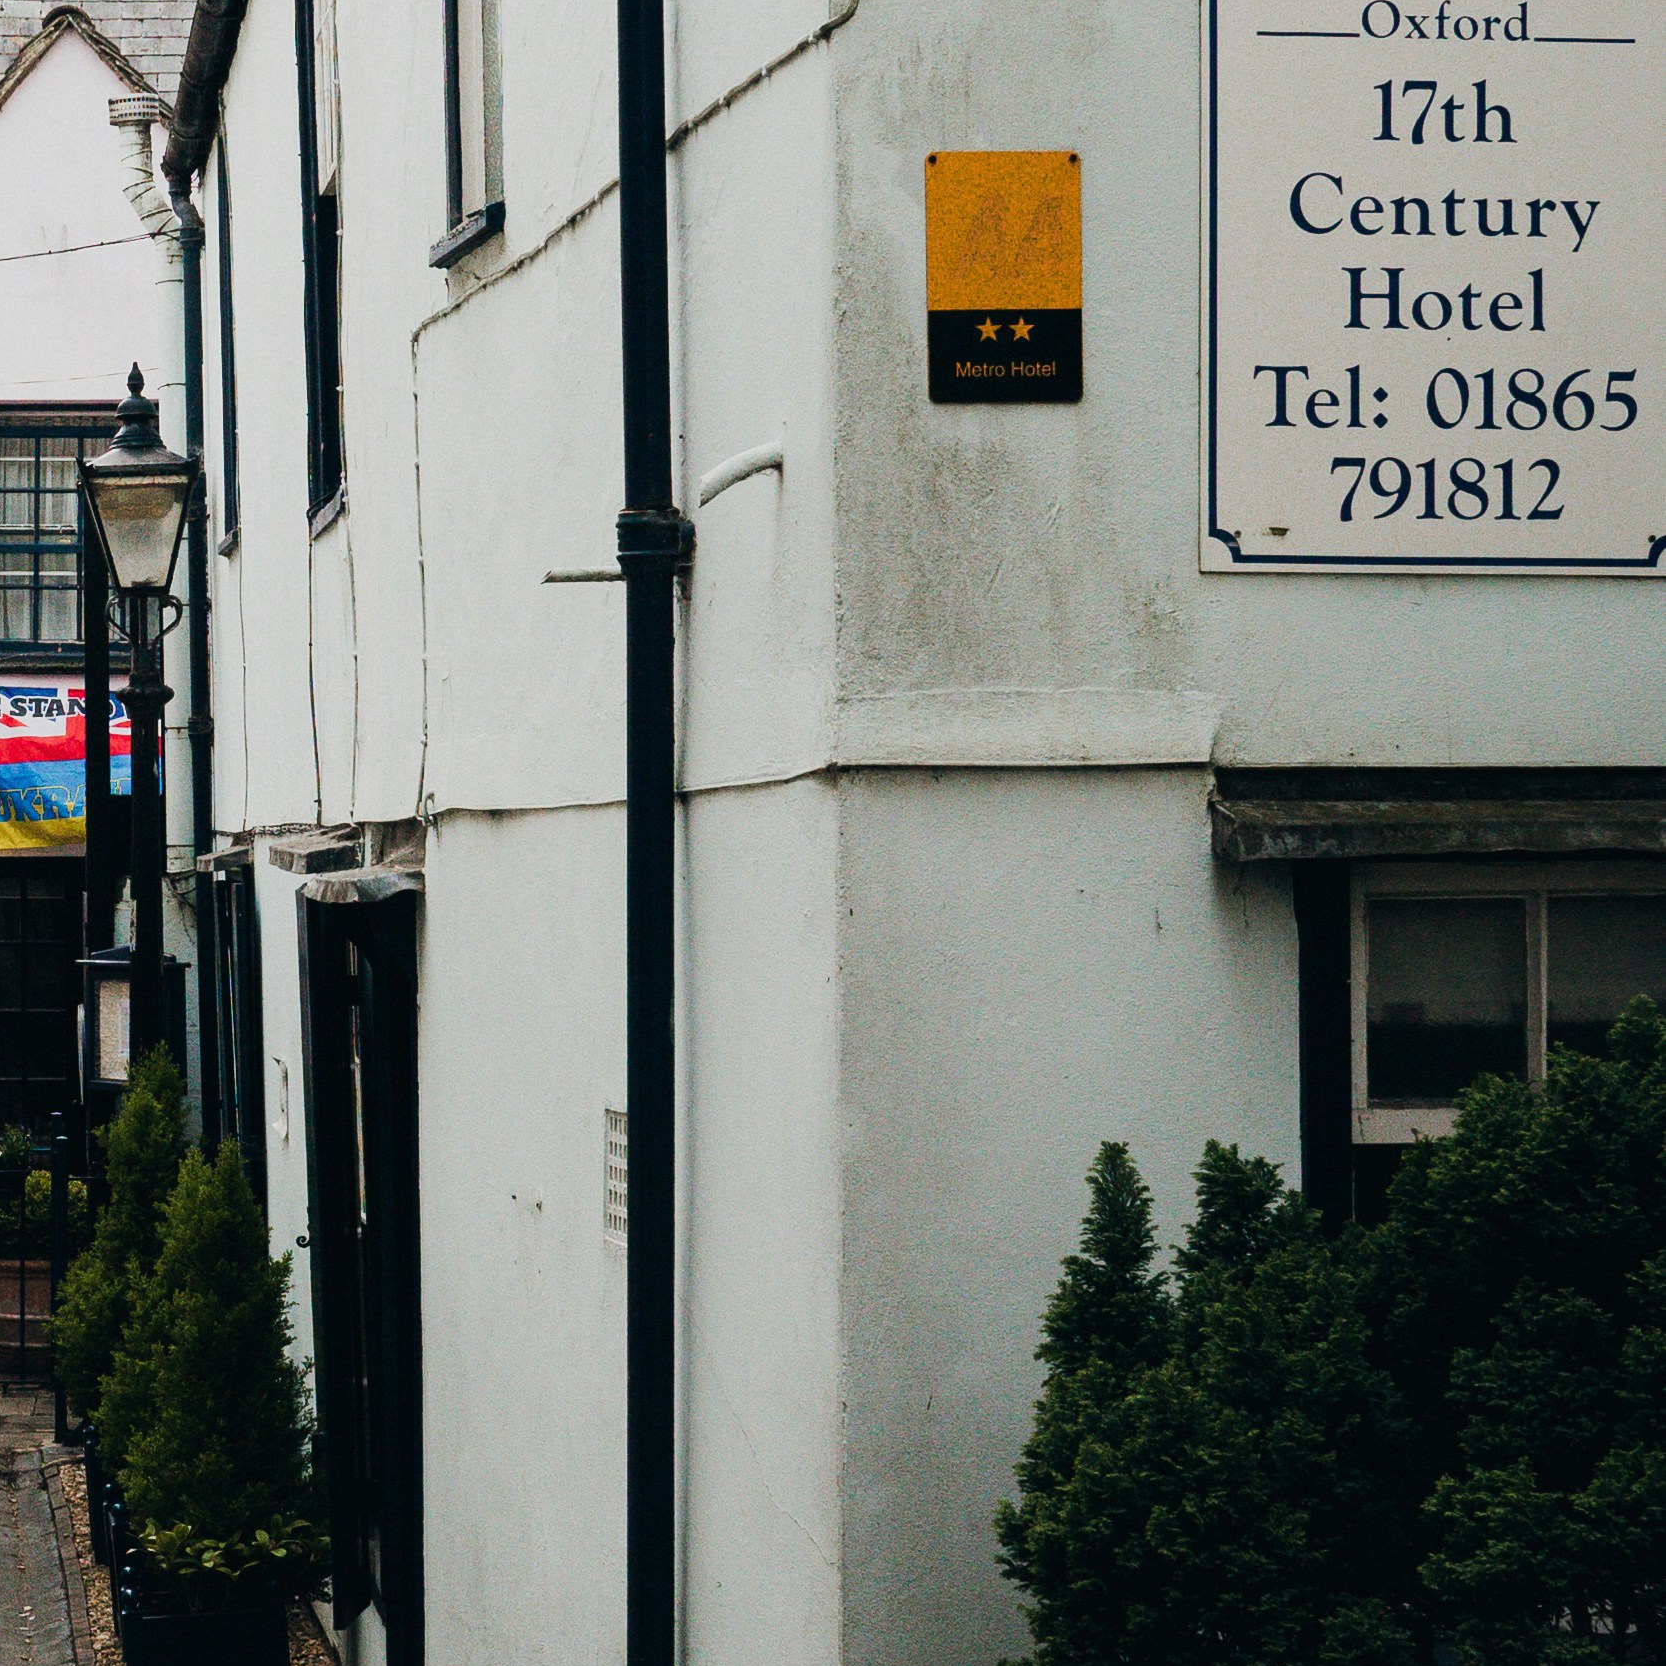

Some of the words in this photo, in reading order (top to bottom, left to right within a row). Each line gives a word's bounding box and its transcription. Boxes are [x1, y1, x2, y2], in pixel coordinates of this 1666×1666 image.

[1361, 0, 1530, 41] Oxford
[1372, 80, 1518, 144] 17th
[1289, 173, 1601, 252] Century
[1342, 267, 1547, 332] Hotel
[955, 361, 1005, 378] Metro
[1011, 361, 1056, 377] Hotel
[1253, 365, 1390, 429] Tel:
[1426, 368, 1638, 431] 01865
[1329, 457, 1565, 522] 791812
[9, 697, 115, 718] STAN
